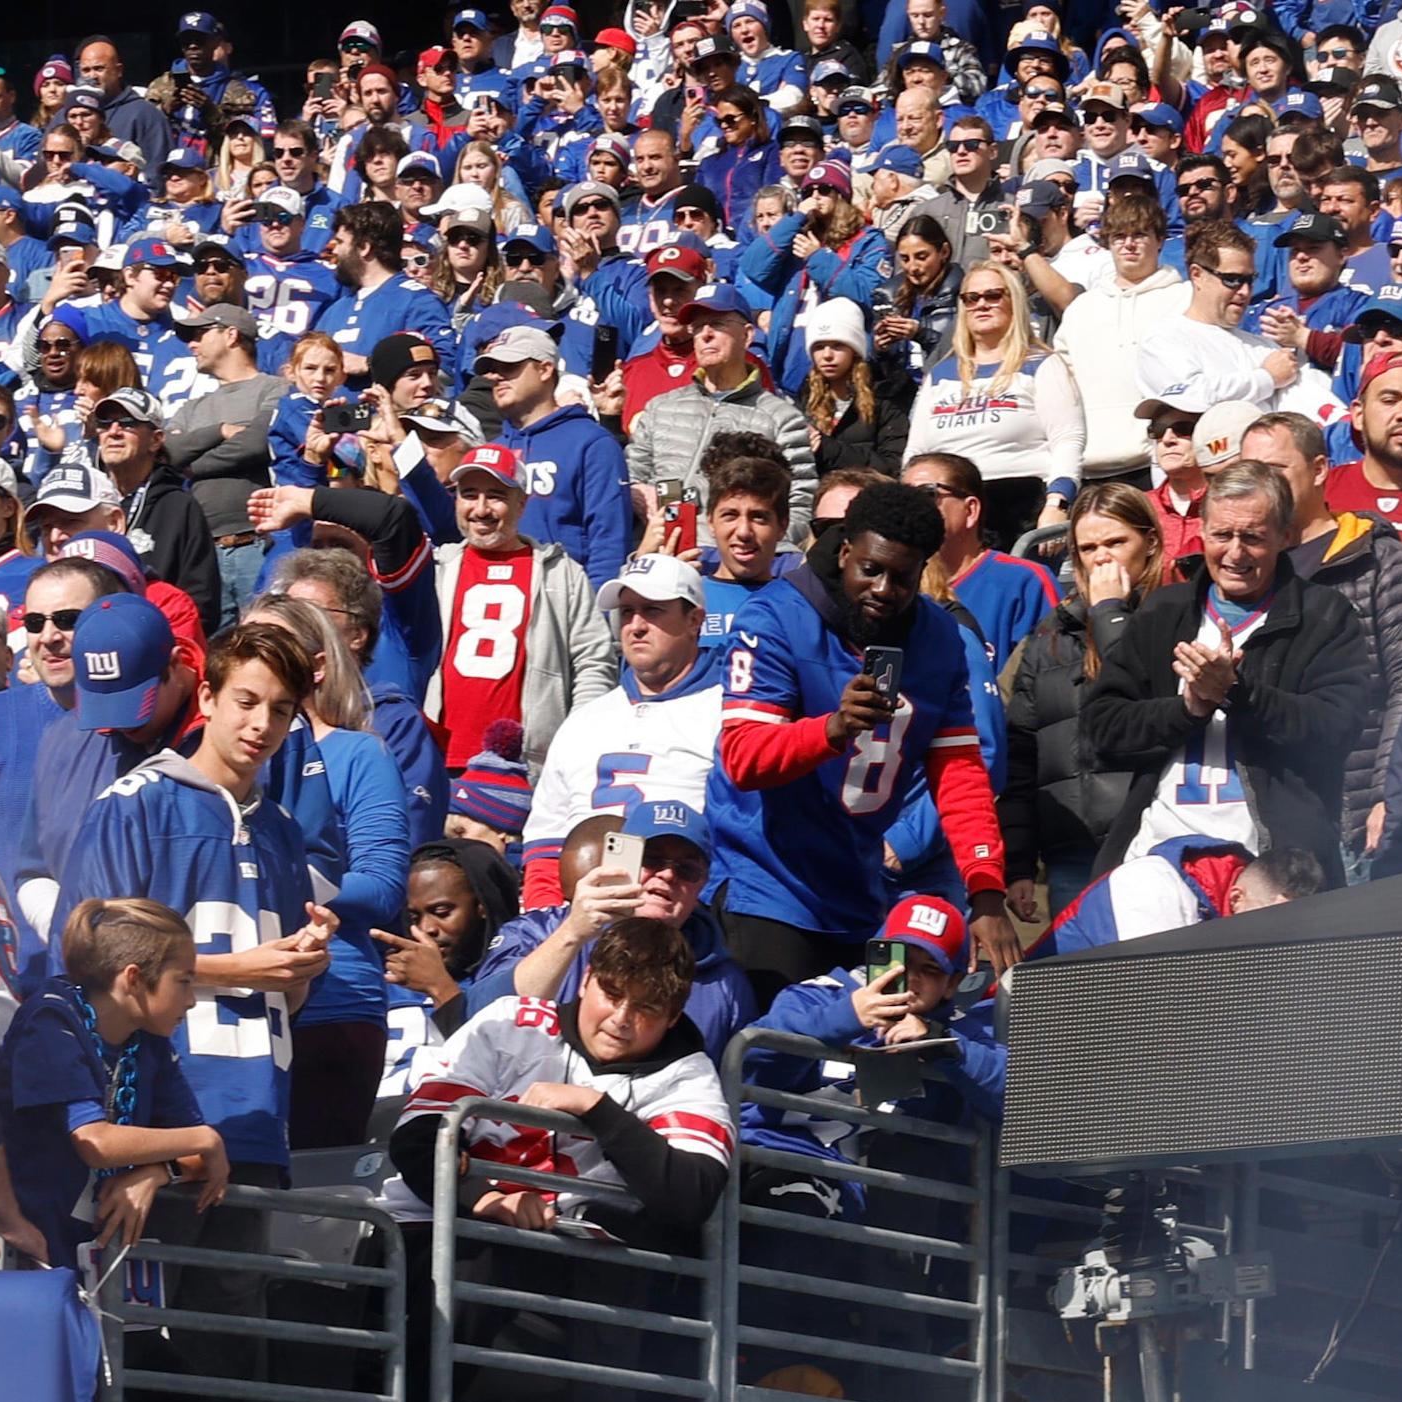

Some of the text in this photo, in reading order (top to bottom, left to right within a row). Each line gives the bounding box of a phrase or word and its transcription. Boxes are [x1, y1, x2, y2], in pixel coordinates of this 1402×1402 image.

[936, 410, 1000, 429] GIANTS
[1207, 437, 1229, 456] W
[453, 583, 527, 679] 8
[84, 651, 121, 681] ny
[729, 649, 755, 694] 8
[593, 753, 652, 816] 5
[907, 905, 947, 938] ny
